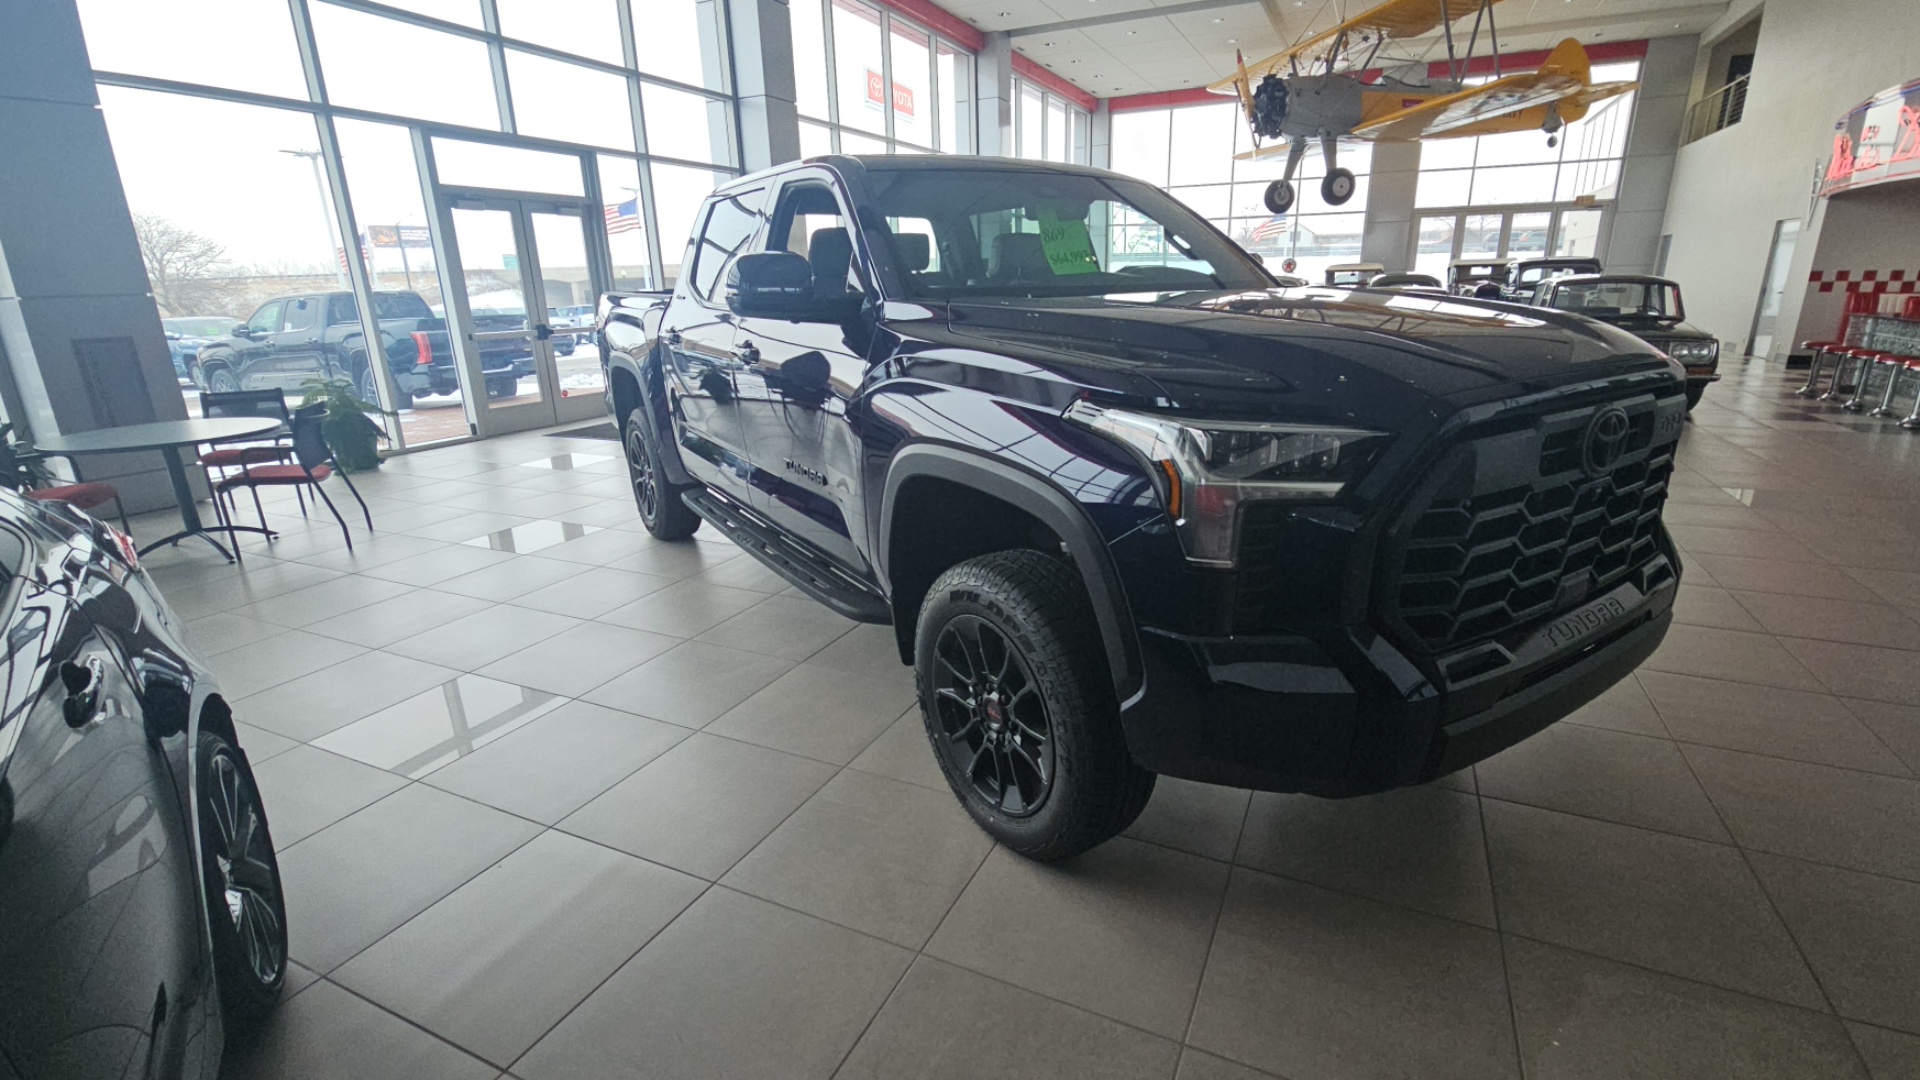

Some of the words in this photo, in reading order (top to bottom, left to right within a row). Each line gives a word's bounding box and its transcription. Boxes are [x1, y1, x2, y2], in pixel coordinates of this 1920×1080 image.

[1043, 226, 1065, 243] 869
[784, 458, 828, 486] TUNDRA
[1542, 597, 1625, 647] TUNDRA
